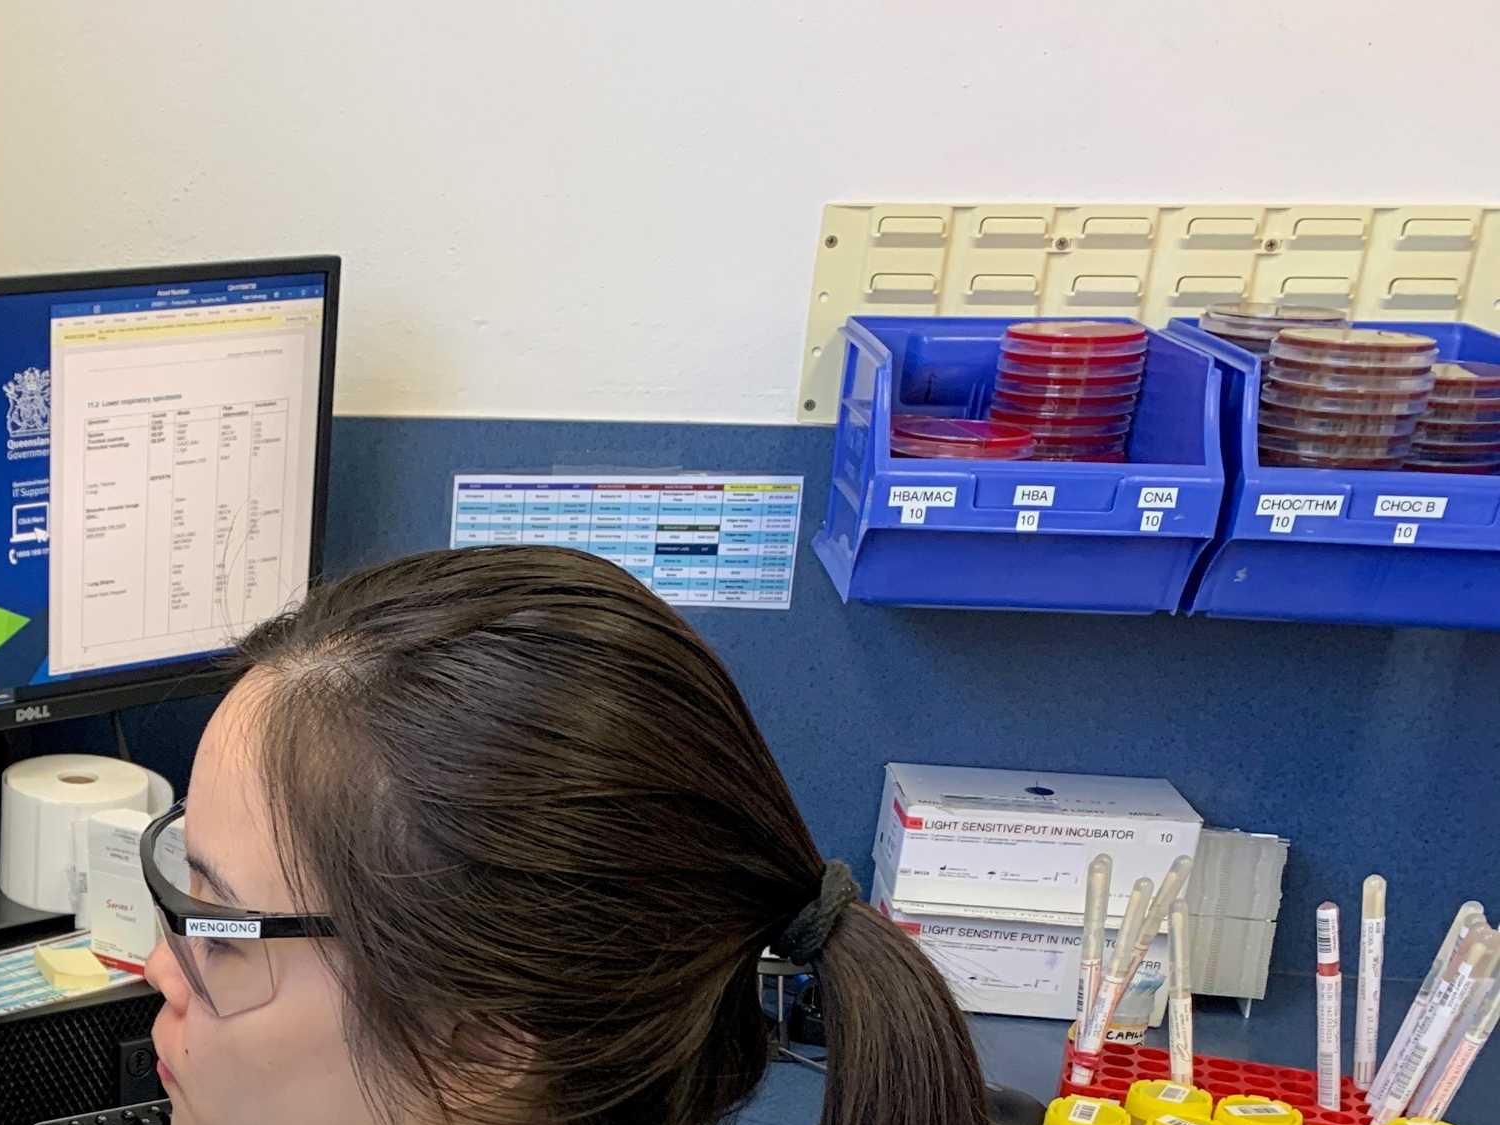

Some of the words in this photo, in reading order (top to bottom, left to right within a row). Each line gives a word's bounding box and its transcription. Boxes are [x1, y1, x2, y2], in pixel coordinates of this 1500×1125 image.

[7, 436, 49, 450] Queenslan
[892, 489, 953, 504] HBA/MAC
[1020, 488, 1048, 503] HBA
[1143, 490, 1174, 504] CNA
[1261, 496, 1339, 513] CHOC/THM
[1380, 499, 1418, 513] CHOC
[1424, 500, 1435, 513] B
[909, 507, 923, 520] 10
[1020, 513, 1035, 527] 10
[1144, 514, 1159, 528] 10
[1274, 515, 1290, 528] 10
[1396, 526, 1413, 539] 10
[15, 705, 51, 722] DELL
[925, 820, 958, 832] LIGHT
[961, 822, 1022, 835] SENSITIVE
[1024, 824, 1047, 836] PUT
[1051, 826, 1063, 837] IN
[1065, 827, 1135, 841] INCUBATOR
[1159, 832, 1174, 844] 10
[188, 921, 258, 934] WENQIONG
[921, 924, 955, 937] LIGHT
[958, 928, 1018, 942] SENSITIVE
[1020, 931, 1044, 943] PUT
[1047, 933, 1059, 945] IN
